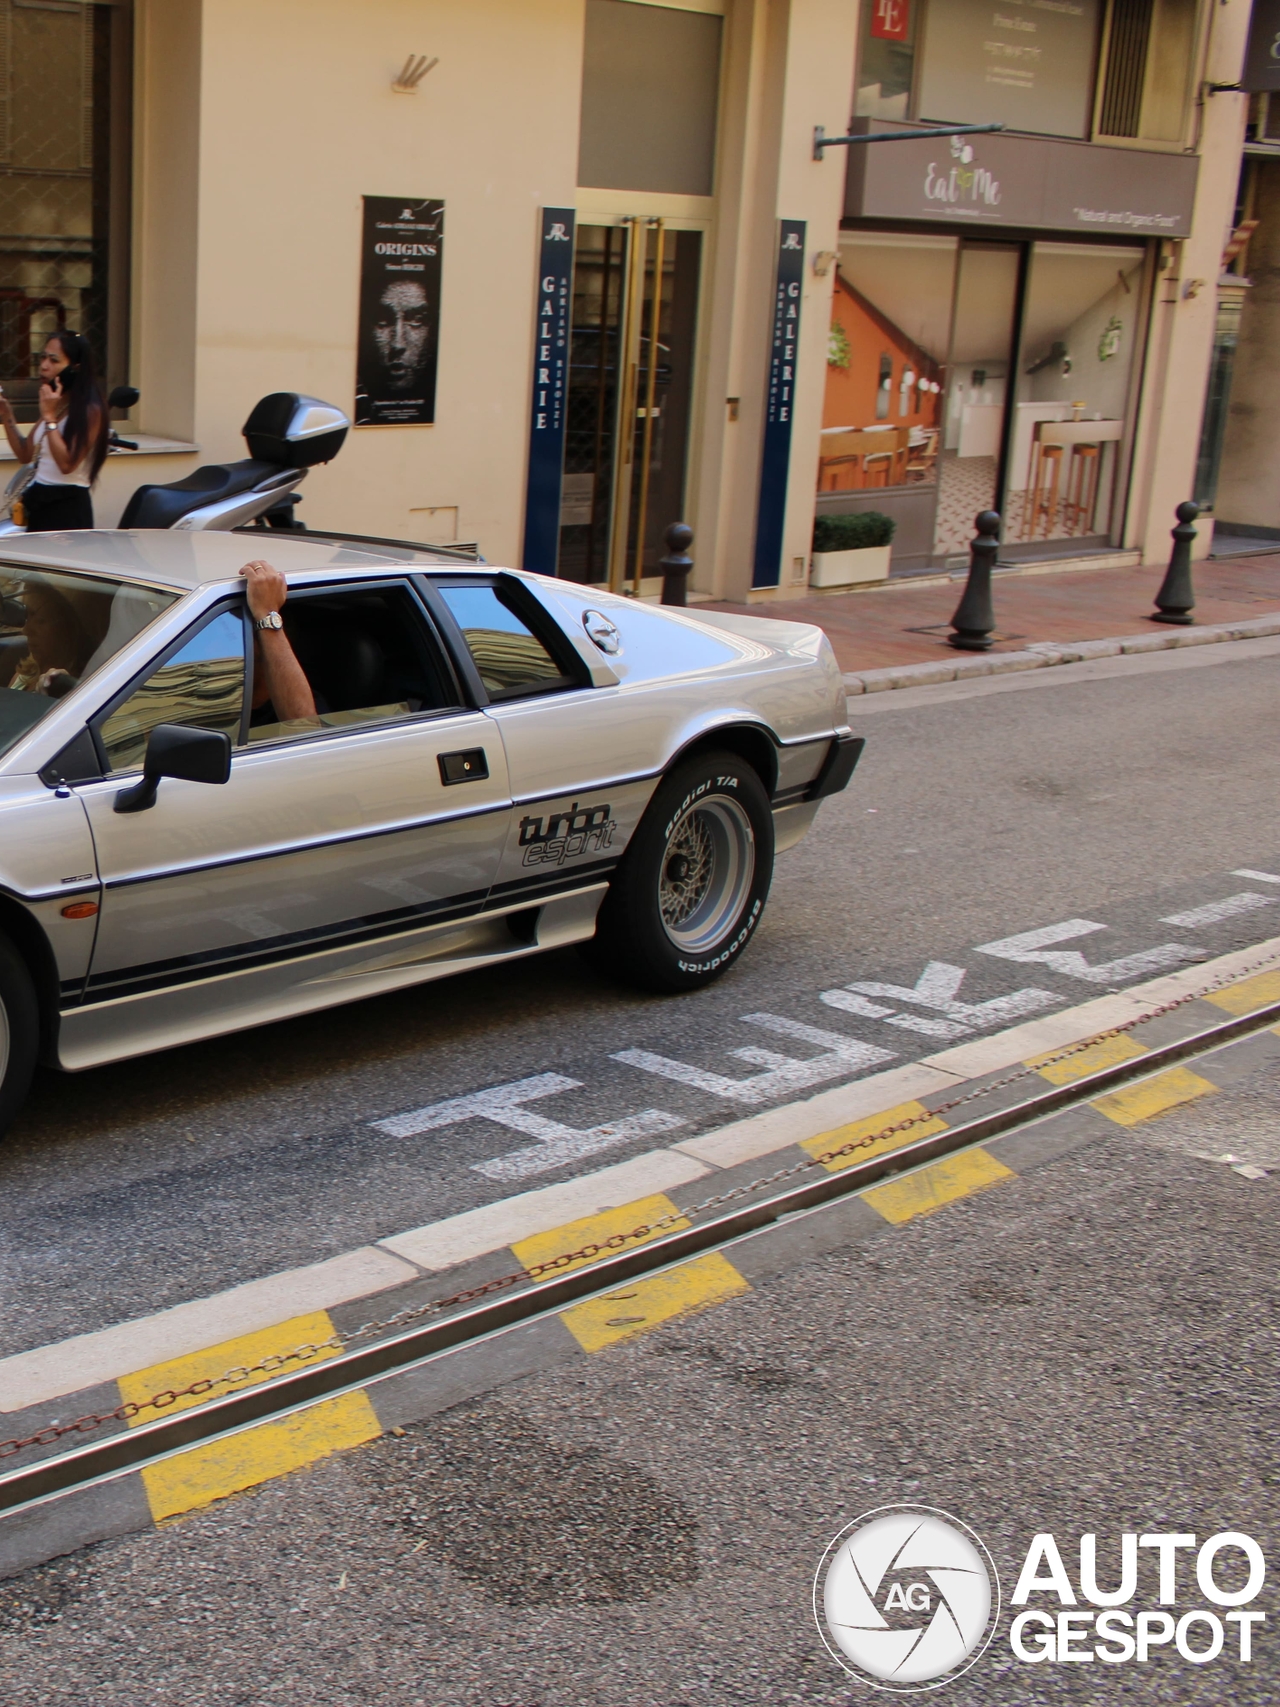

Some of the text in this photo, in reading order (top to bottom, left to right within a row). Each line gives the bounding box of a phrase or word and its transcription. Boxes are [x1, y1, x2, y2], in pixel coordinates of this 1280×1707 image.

[924, 162, 1002, 205] Eat Me
[374, 242, 437, 256] ORIGINS
[556, 277, 568, 347] ADRIANO
[536, 276, 555, 429] GALERIE
[779, 282, 799, 421] GALERIE
[716, 776, 738, 788] T/A
[519, 802, 611, 846] turbo
[522, 819, 617, 867] esprit
[678, 899, 761, 973] BFGoodrich
